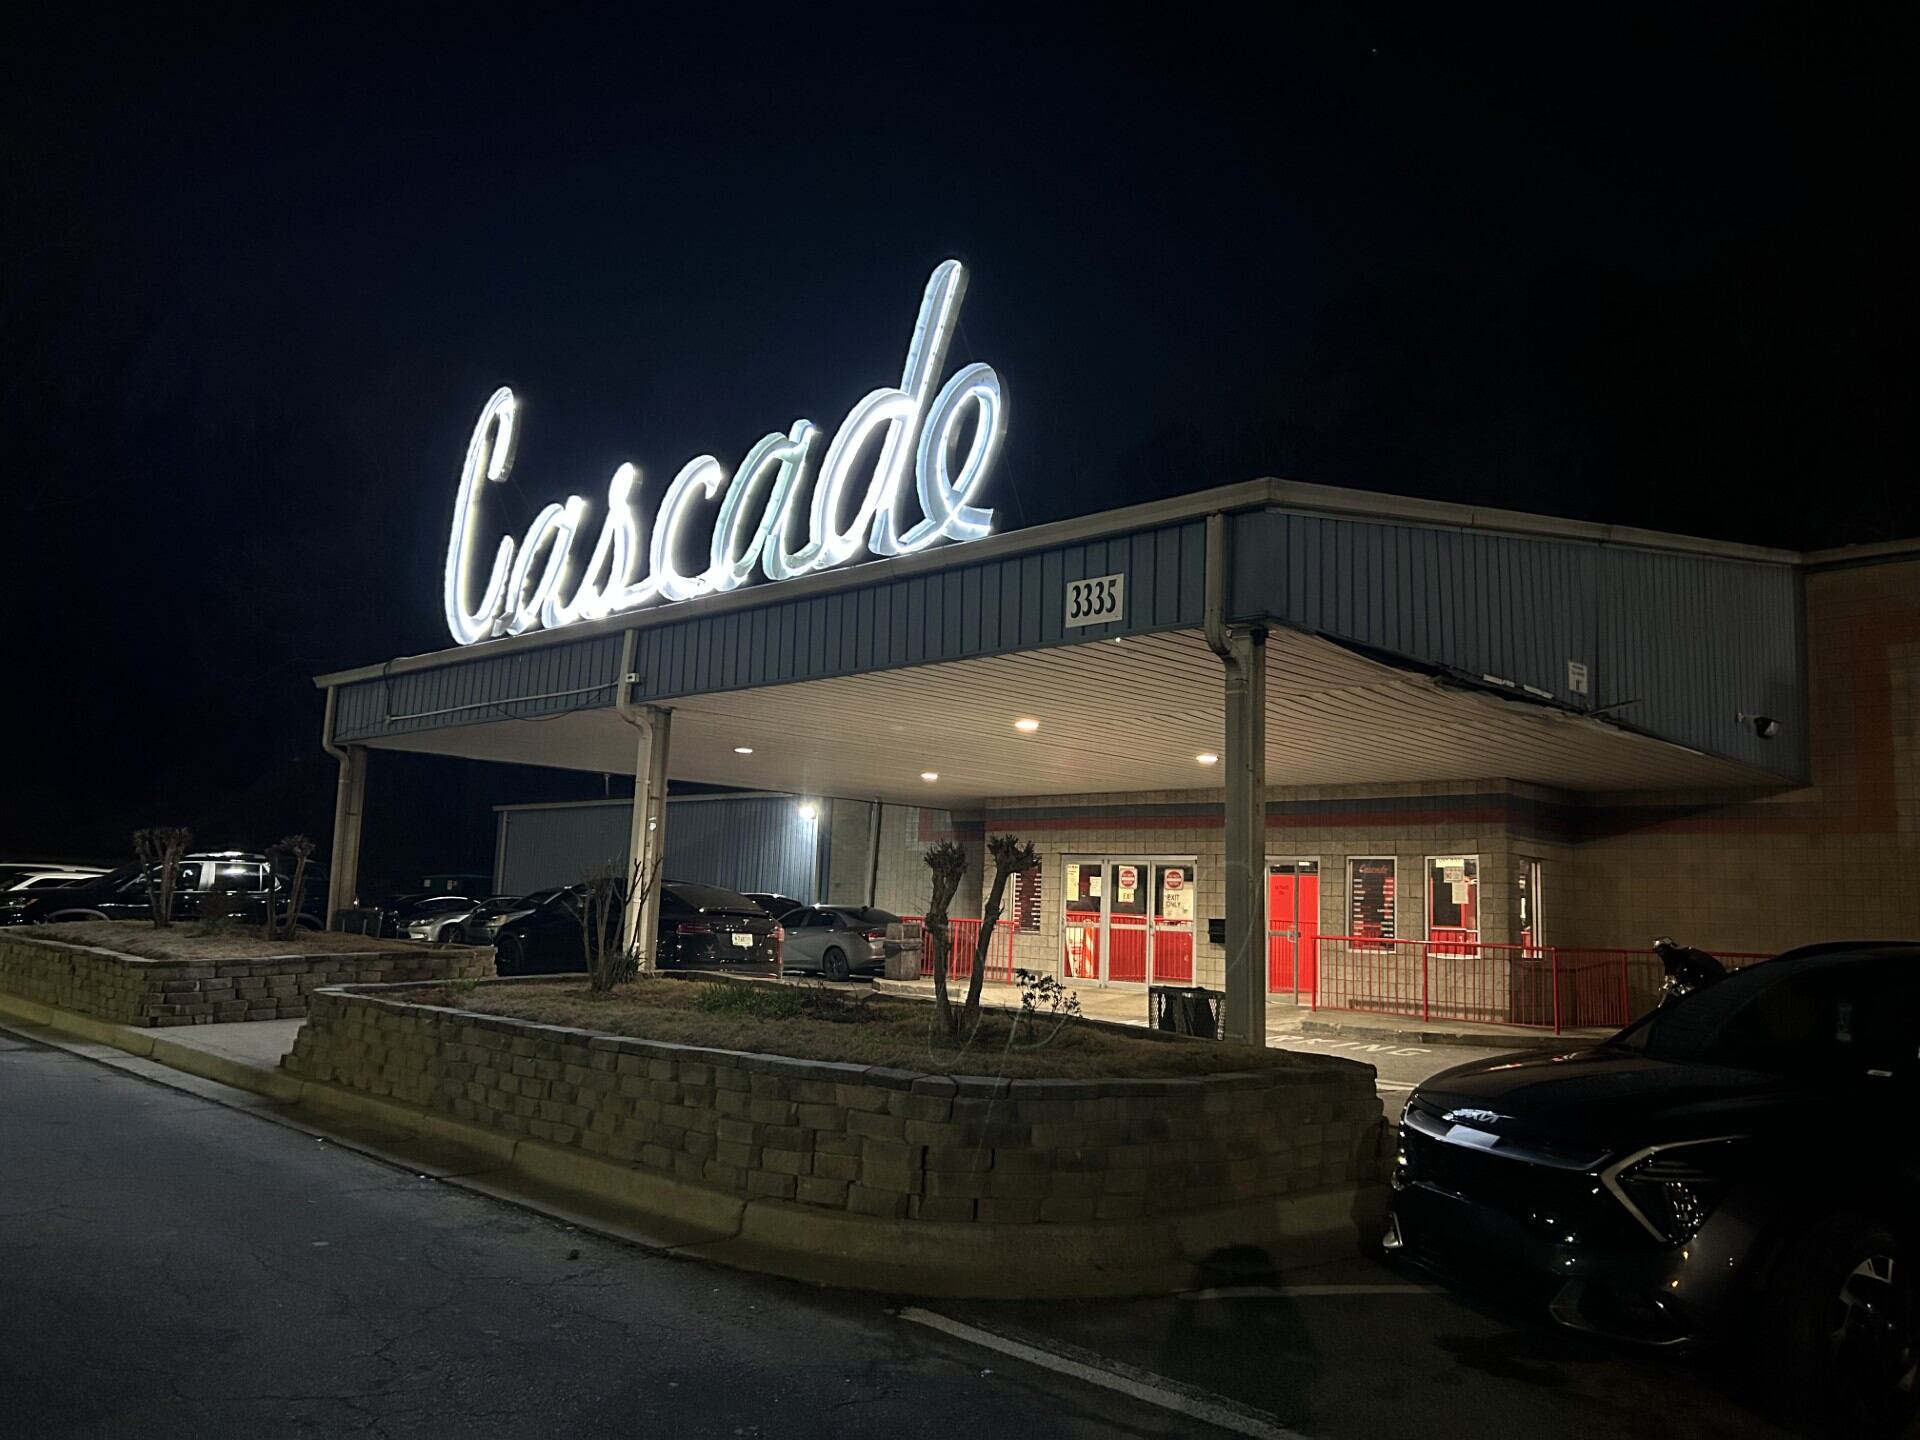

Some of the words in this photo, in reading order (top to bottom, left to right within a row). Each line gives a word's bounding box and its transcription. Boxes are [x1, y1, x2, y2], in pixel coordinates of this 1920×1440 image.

[445, 259, 1005, 645] Cascade
[1071, 579, 1117, 618] 3335
[1266, 1034, 1432, 1056] RKING
